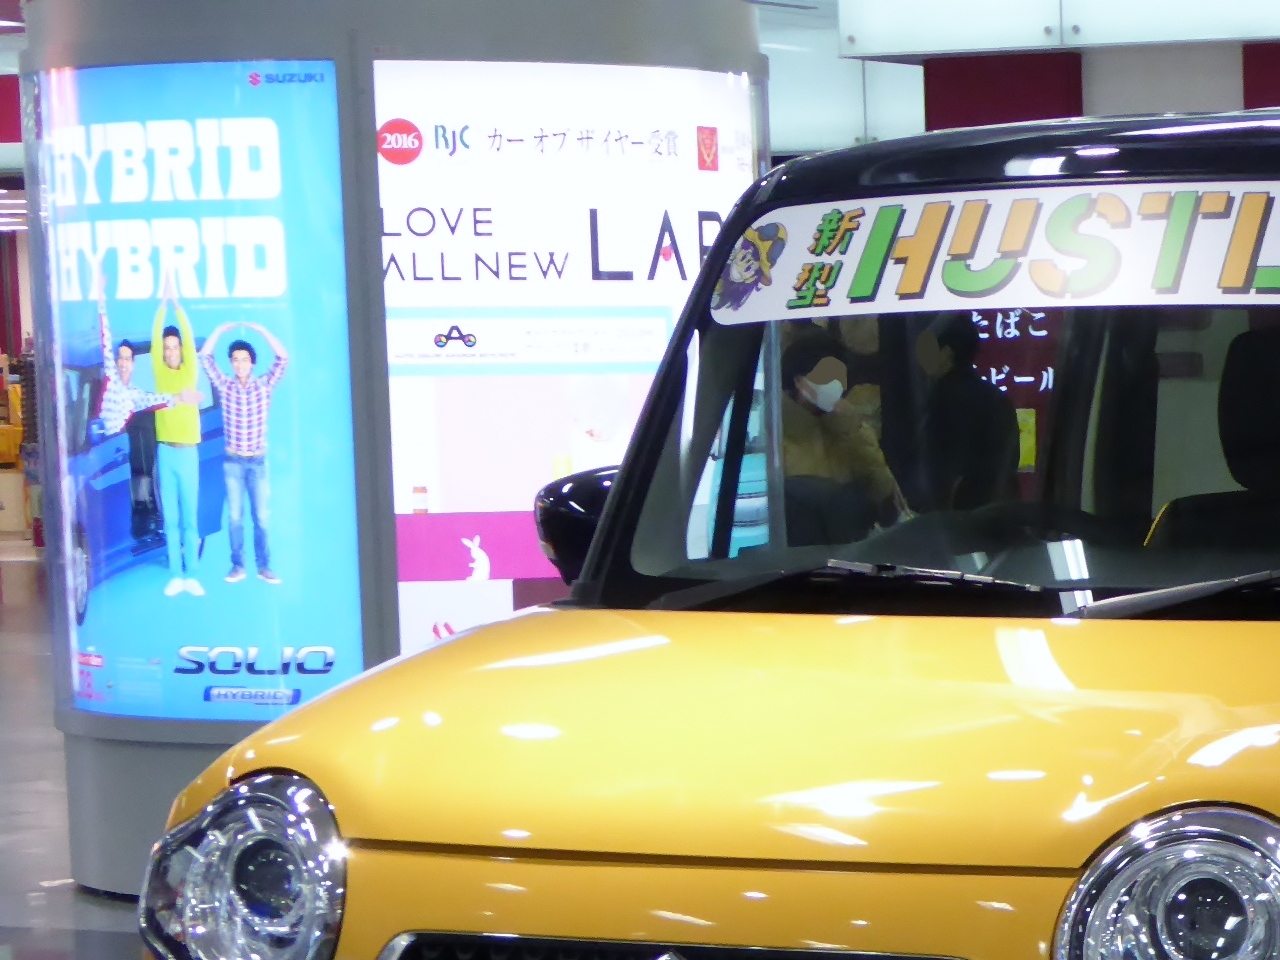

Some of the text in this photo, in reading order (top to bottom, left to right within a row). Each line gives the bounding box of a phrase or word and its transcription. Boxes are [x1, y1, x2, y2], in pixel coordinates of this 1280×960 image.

[264, 72, 325, 84] SUZUKI
[381, 132, 420, 151] 2016
[433, 124, 471, 157] RJC
[51, 116, 282, 207] HYBRID
[380, 207, 493, 237] LOVE
[56, 215, 288, 302] HYBRID
[383, 252, 569, 282] ALL NEW
[785, 207, 864, 309] 新型
[173, 645, 335, 675] SOLIO
[216, 689, 287, 701] HYBRID
